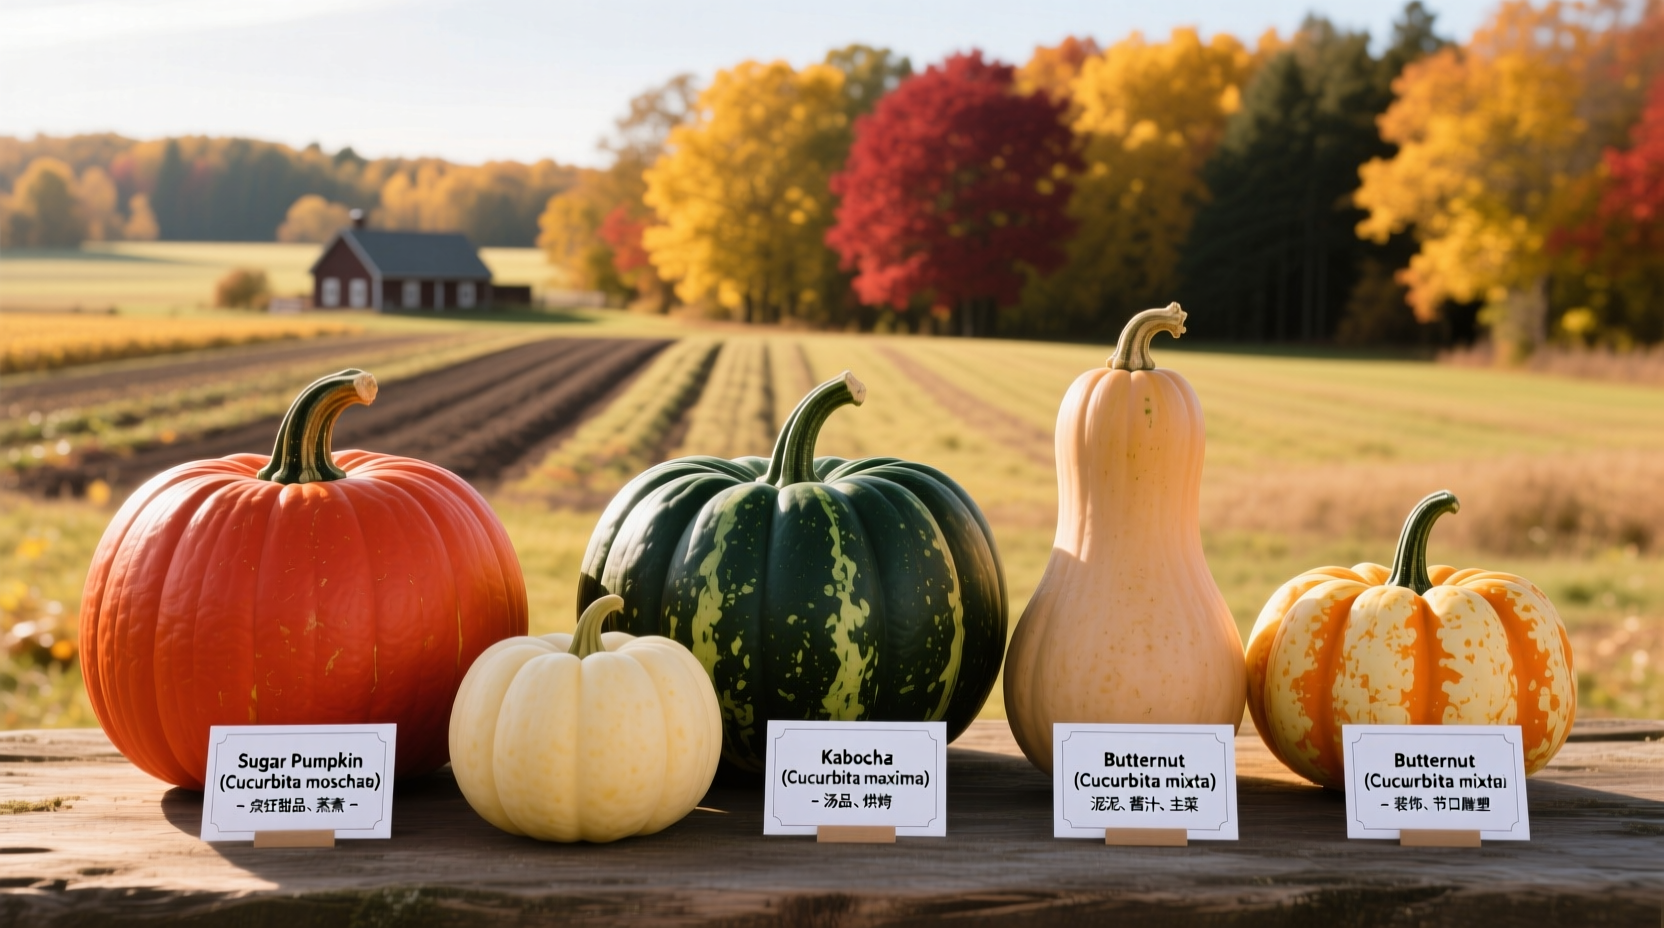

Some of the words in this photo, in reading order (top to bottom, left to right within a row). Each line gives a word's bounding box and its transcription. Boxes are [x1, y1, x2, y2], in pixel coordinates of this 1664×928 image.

[237, 752, 287, 773] Sugar
[291, 751, 363, 772] Pumpkin
[821, 748, 893, 766] Kabocha
[1104, 751, 1186, 769] Butternut
[1394, 752, 1476, 769] Butternut
[219, 773, 302, 793] (Cucurbita
[781, 769, 861, 788] (Cucurbita
[864, 769, 930, 789] maxima)
[1074, 771, 1161, 791] (Cucurbita
[1165, 772, 1217, 792] mixta)
